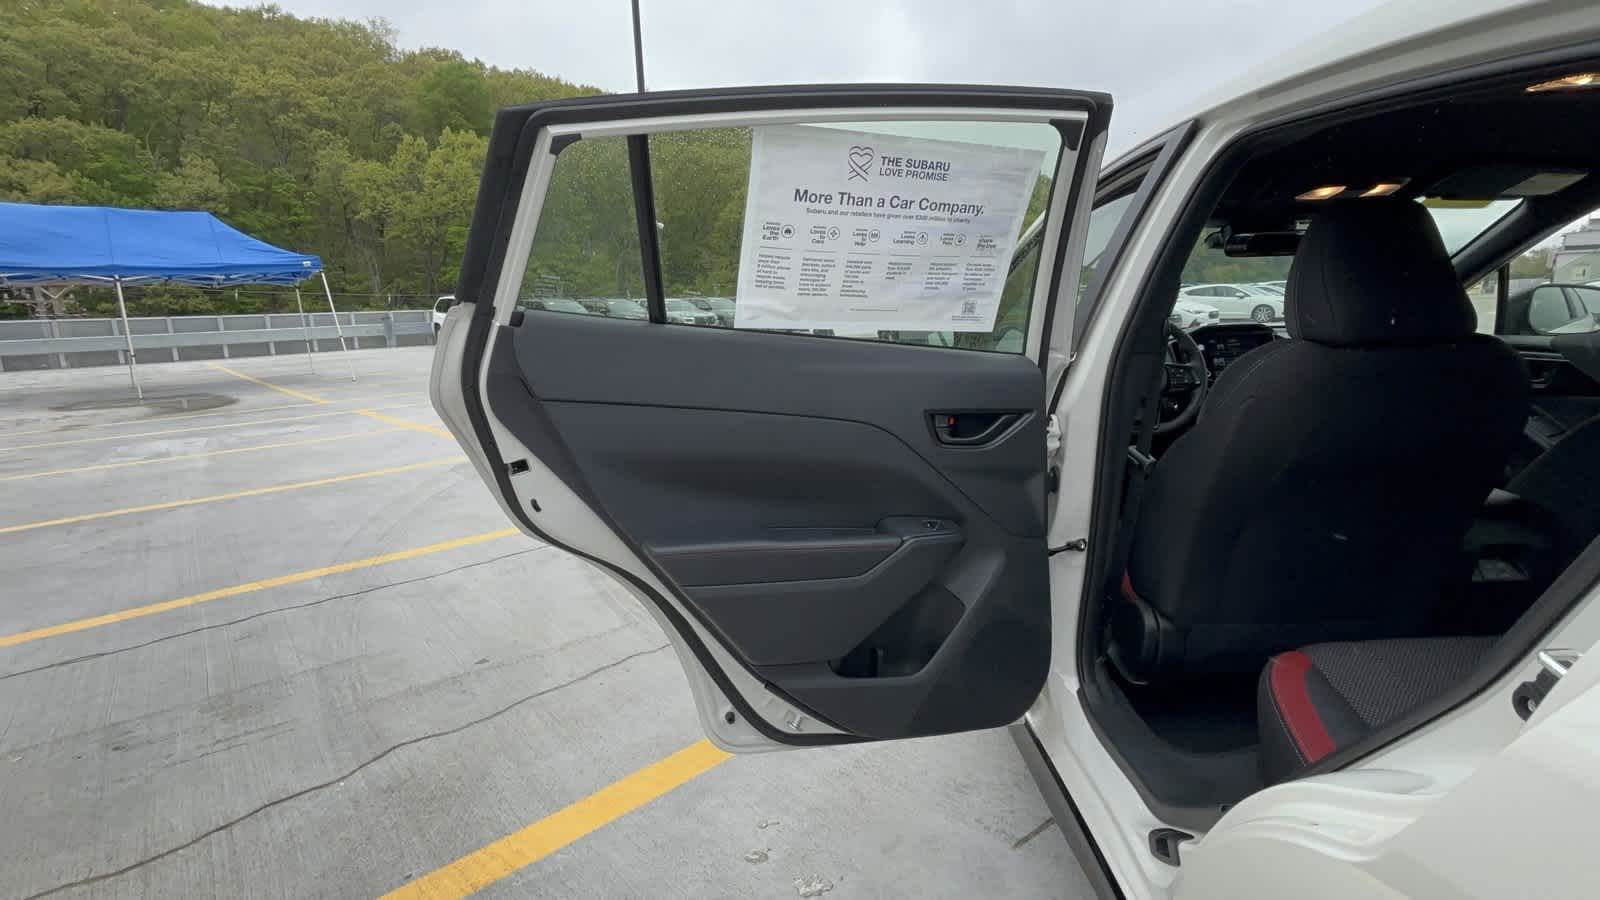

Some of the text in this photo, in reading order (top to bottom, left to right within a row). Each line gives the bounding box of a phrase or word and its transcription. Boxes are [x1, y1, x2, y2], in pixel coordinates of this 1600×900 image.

[881, 156, 951, 172] THE SUBARU
[879, 168, 949, 181] LOVE PROMISE
[793, 188, 984, 216] More Than a Car Company.
